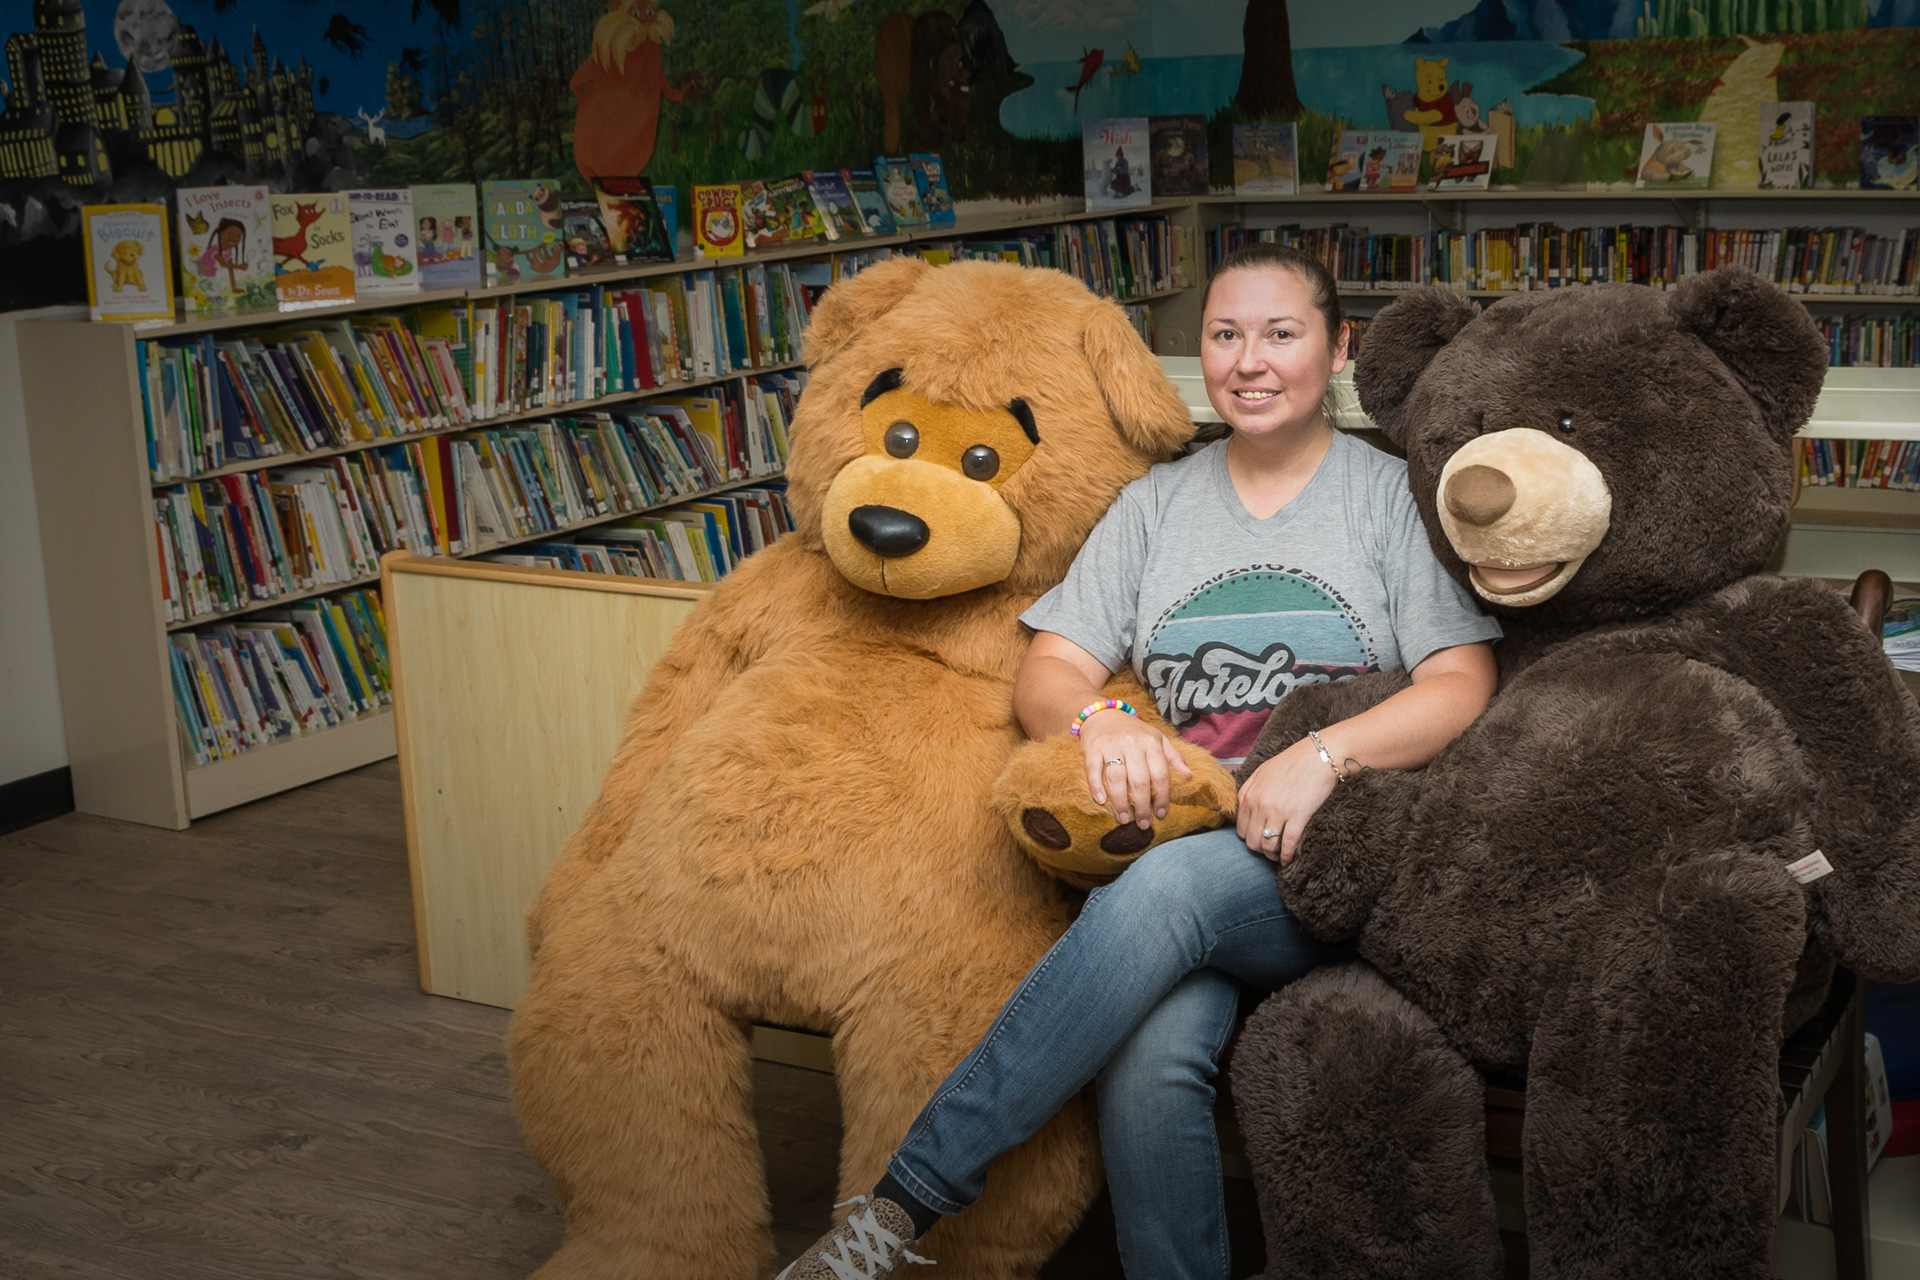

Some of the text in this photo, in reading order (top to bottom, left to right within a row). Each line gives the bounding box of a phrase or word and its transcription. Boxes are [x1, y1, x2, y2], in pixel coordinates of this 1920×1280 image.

[1099, 129, 1133, 145] Wish
[185, 191, 220, 208] I Love
[697, 188, 738, 201] COWBOY
[707, 197, 731, 207] PUG
[210, 199, 251, 213] Insects
[272, 203, 294, 221] Fox
[488, 201, 533, 216] PANDA
[379, 217, 398, 230] Eat
[97, 227, 155, 243] Biscuit
[311, 229, 345, 249] Socks
[491, 224, 537, 240] SLOTH
[296, 284, 312, 296] Dr.
[314, 284, 341, 296] Seuss
[1146, 646, 1357, 727] Antelo
